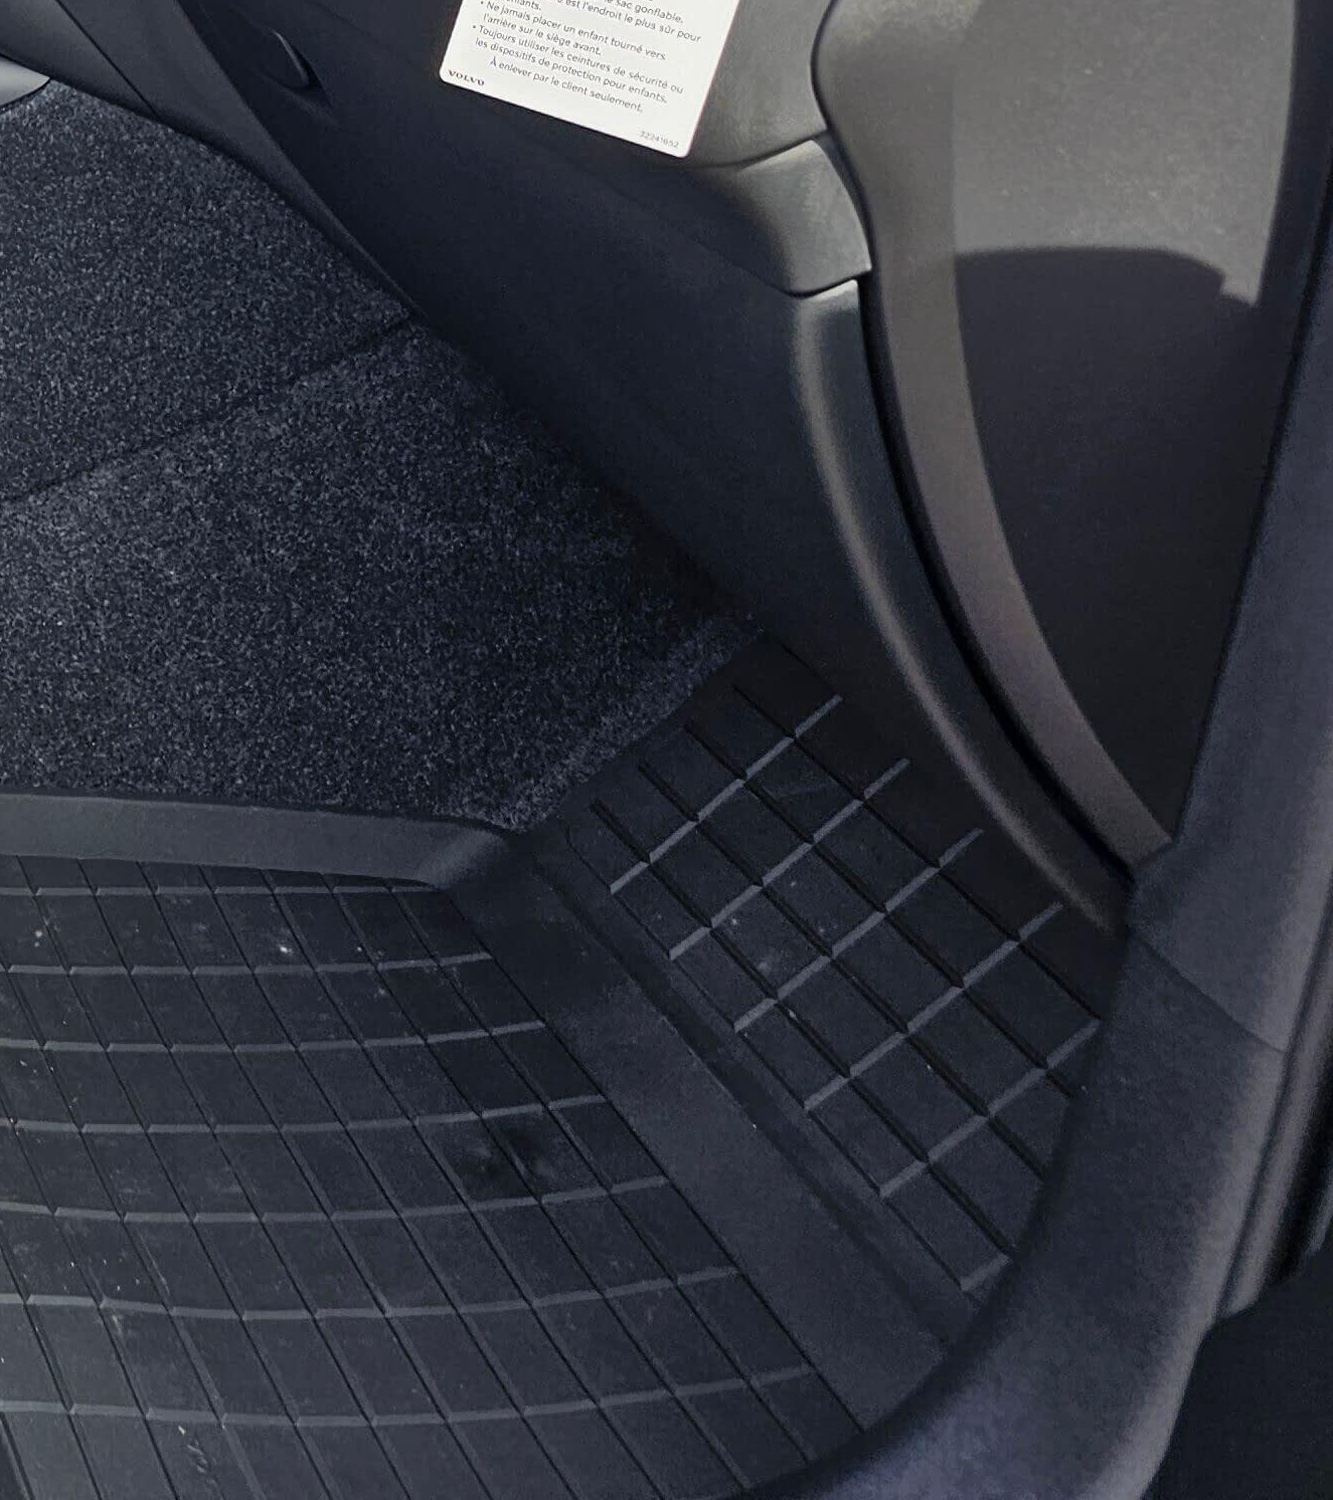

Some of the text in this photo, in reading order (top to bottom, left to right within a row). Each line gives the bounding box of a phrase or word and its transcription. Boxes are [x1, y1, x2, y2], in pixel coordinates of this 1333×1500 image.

[615, 0, 633, 10] sac
[486, 0, 500, 12] Ne
[499, 4, 531, 21] jamais
[531, 15, 562, 30] placer
[563, 25, 576, 34] un
[577, 29, 609, 44] enfant
[645, 48, 666, 61] vers
[518, 25, 534, 35] sur
[534, 28, 544, 39] le
[623, 12, 634, 24] le
[634, 18, 656, 30] plus
[676, 30, 702, 42] pour
[475, 37, 488, 49] les
[490, 42, 537, 64] dispositifs
[537, 56, 551, 68] de
[550, 62, 602, 83] protection
[602, 78, 627, 90] pour
[479, 24, 516, 44] Toujours
[518, 38, 550, 53] utiliser
[550, 46, 565, 58] les
[566, 53, 611, 73] ceintures
[612, 66, 626, 77] de
[670, 84, 684, 94] ou
[498, 62, 533, 77] enlever
[532, 72, 550, 83] par
[550, 75, 561, 87] le
[561, 80, 588, 96] client
